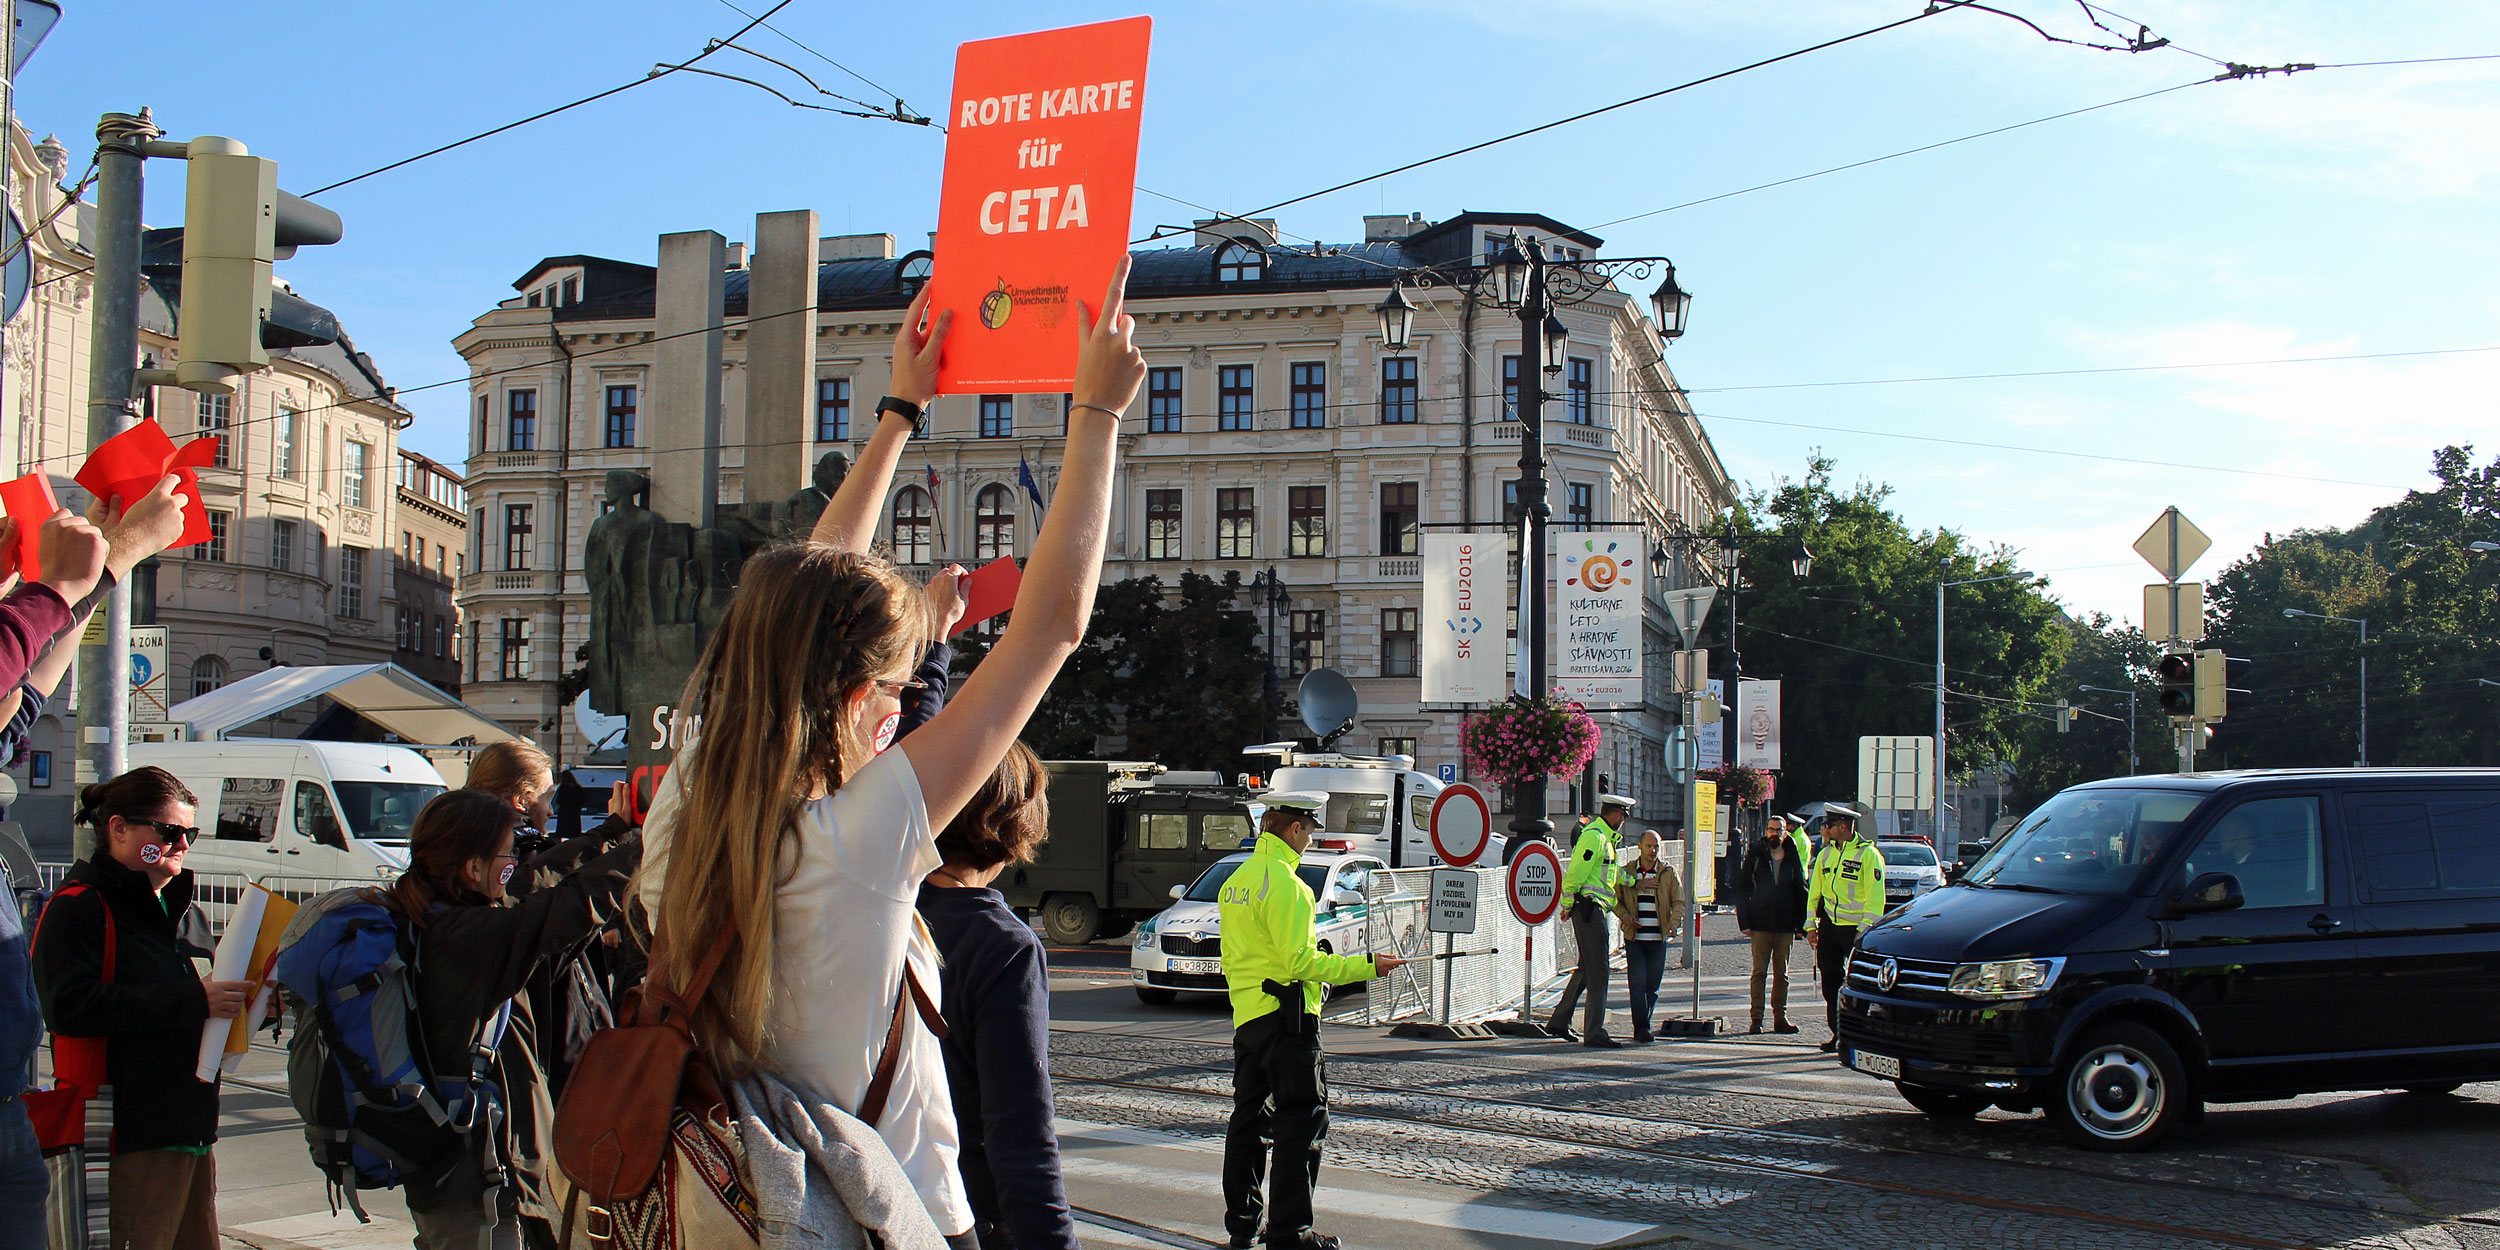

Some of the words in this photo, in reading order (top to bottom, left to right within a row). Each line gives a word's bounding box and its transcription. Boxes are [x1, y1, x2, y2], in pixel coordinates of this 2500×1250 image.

[960, 93, 1032, 128] ROTE
[1040, 80, 1134, 119] KARTE
[1018, 138, 1062, 169] für
[979, 184, 1089, 235] CETA
[1011, 286, 1069, 297] Umweltinstitut
[1458, 544, 1473, 611] EU2016
[1569, 597, 1623, 613] KULTÚRNE
[1569, 614, 1600, 627] LETO
[139, 634, 164, 648] ZÓNA
[1569, 631, 1577, 644] A
[1579, 628, 1619, 645] HRADNÉ
[1457, 639, 1471, 659] SK
[1570, 646, 1632, 662] SLÁVNOSTI
[1569, 665, 1613, 674] BRATISLAVA
[1615, 665, 1632, 674] 2016
[1443, 766, 1451, 779] P
[1526, 866, 1546, 878] STOP
[1446, 880, 1464, 888] OKREM
[1442, 889, 1466, 899] VOZIDIEL
[1519, 886, 1552, 897] KONTROLA
[1444, 910, 1455, 918] MZV
[1457, 911, 1464, 919] SR
[1870, 1055, 1899, 1076] 00589
